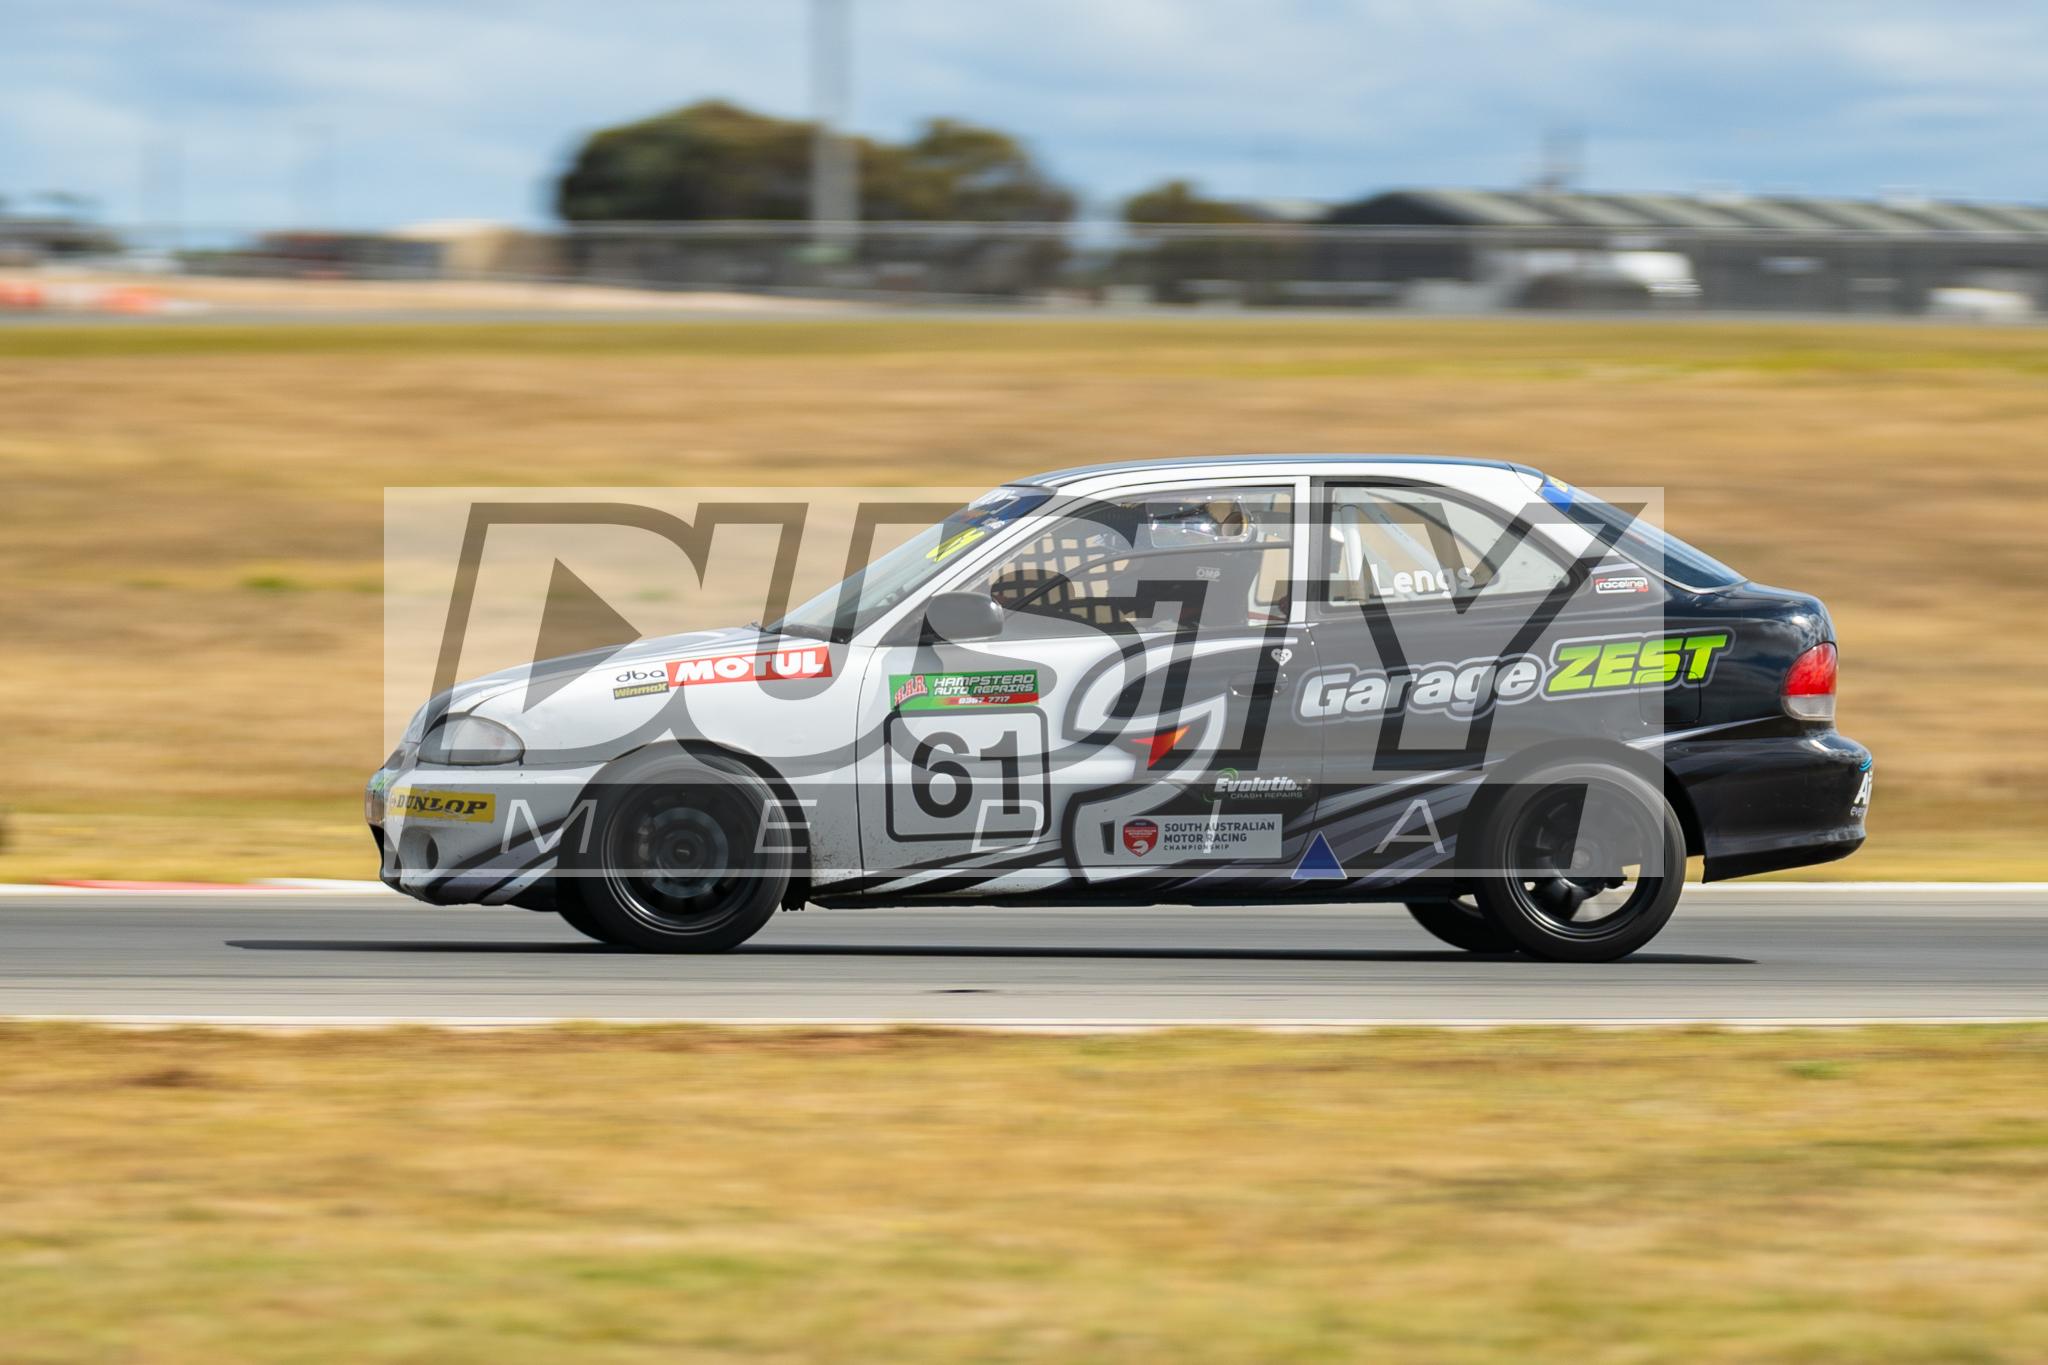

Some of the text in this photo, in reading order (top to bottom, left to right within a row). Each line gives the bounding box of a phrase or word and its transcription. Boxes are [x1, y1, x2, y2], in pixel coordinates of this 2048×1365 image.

[1370, 564, 1475, 599] Lengs
[675, 651, 825, 682] MOTUL
[616, 670, 665, 682] dba
[934, 674, 1035, 687] HAMPSTEAD
[1300, 634, 1728, 717] Garage ZEST
[934, 683, 1034, 695] AUTO REPAIRS
[911, 731, 1020, 818] 61
[1265, 791, 1303, 799] REPAIRS
[396, 794, 488, 815] DUNLOP
[1164, 822, 1203, 833] SOUTH
[1205, 821, 1275, 832] AUSTRALIAN
[1164, 832, 1248, 844] MOTOR RACING
